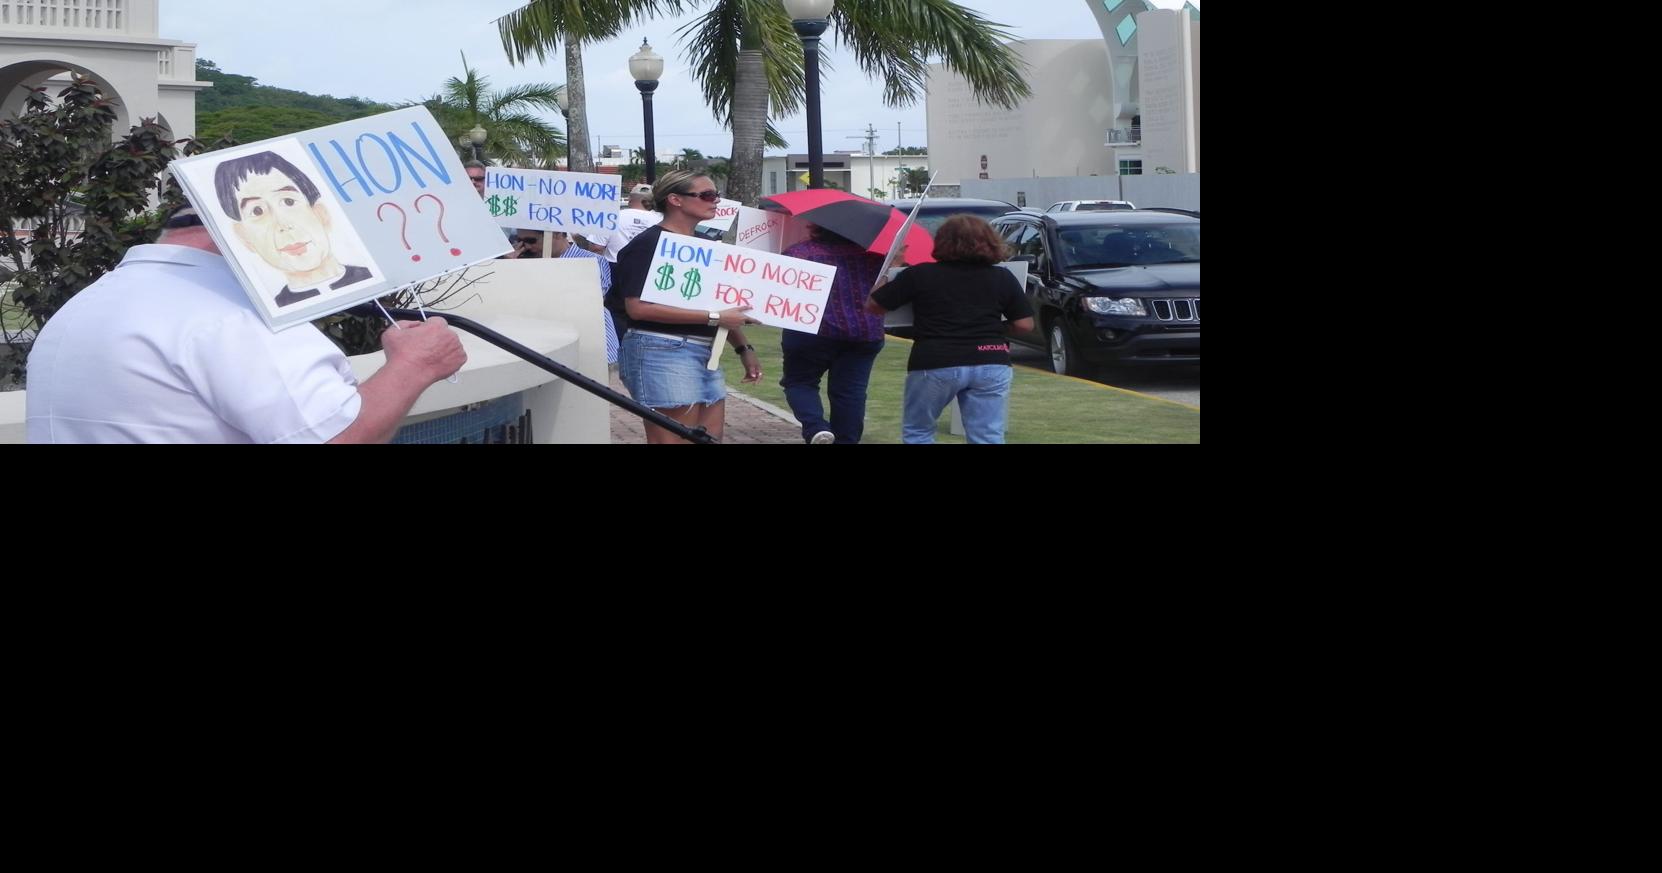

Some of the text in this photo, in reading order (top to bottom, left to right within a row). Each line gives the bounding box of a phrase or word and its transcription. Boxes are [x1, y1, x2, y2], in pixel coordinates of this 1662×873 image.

[307, 121, 452, 203] HON
[528, 202, 563, 225] FOR
[571, 207, 618, 231] RMS
[713, 207, 738, 217] ROCK
[738, 218, 779, 242] DEFROCK
[761, 262, 828, 292] MORE
[715, 283, 755, 311] FOR
[764, 293, 820, 326] RMS
